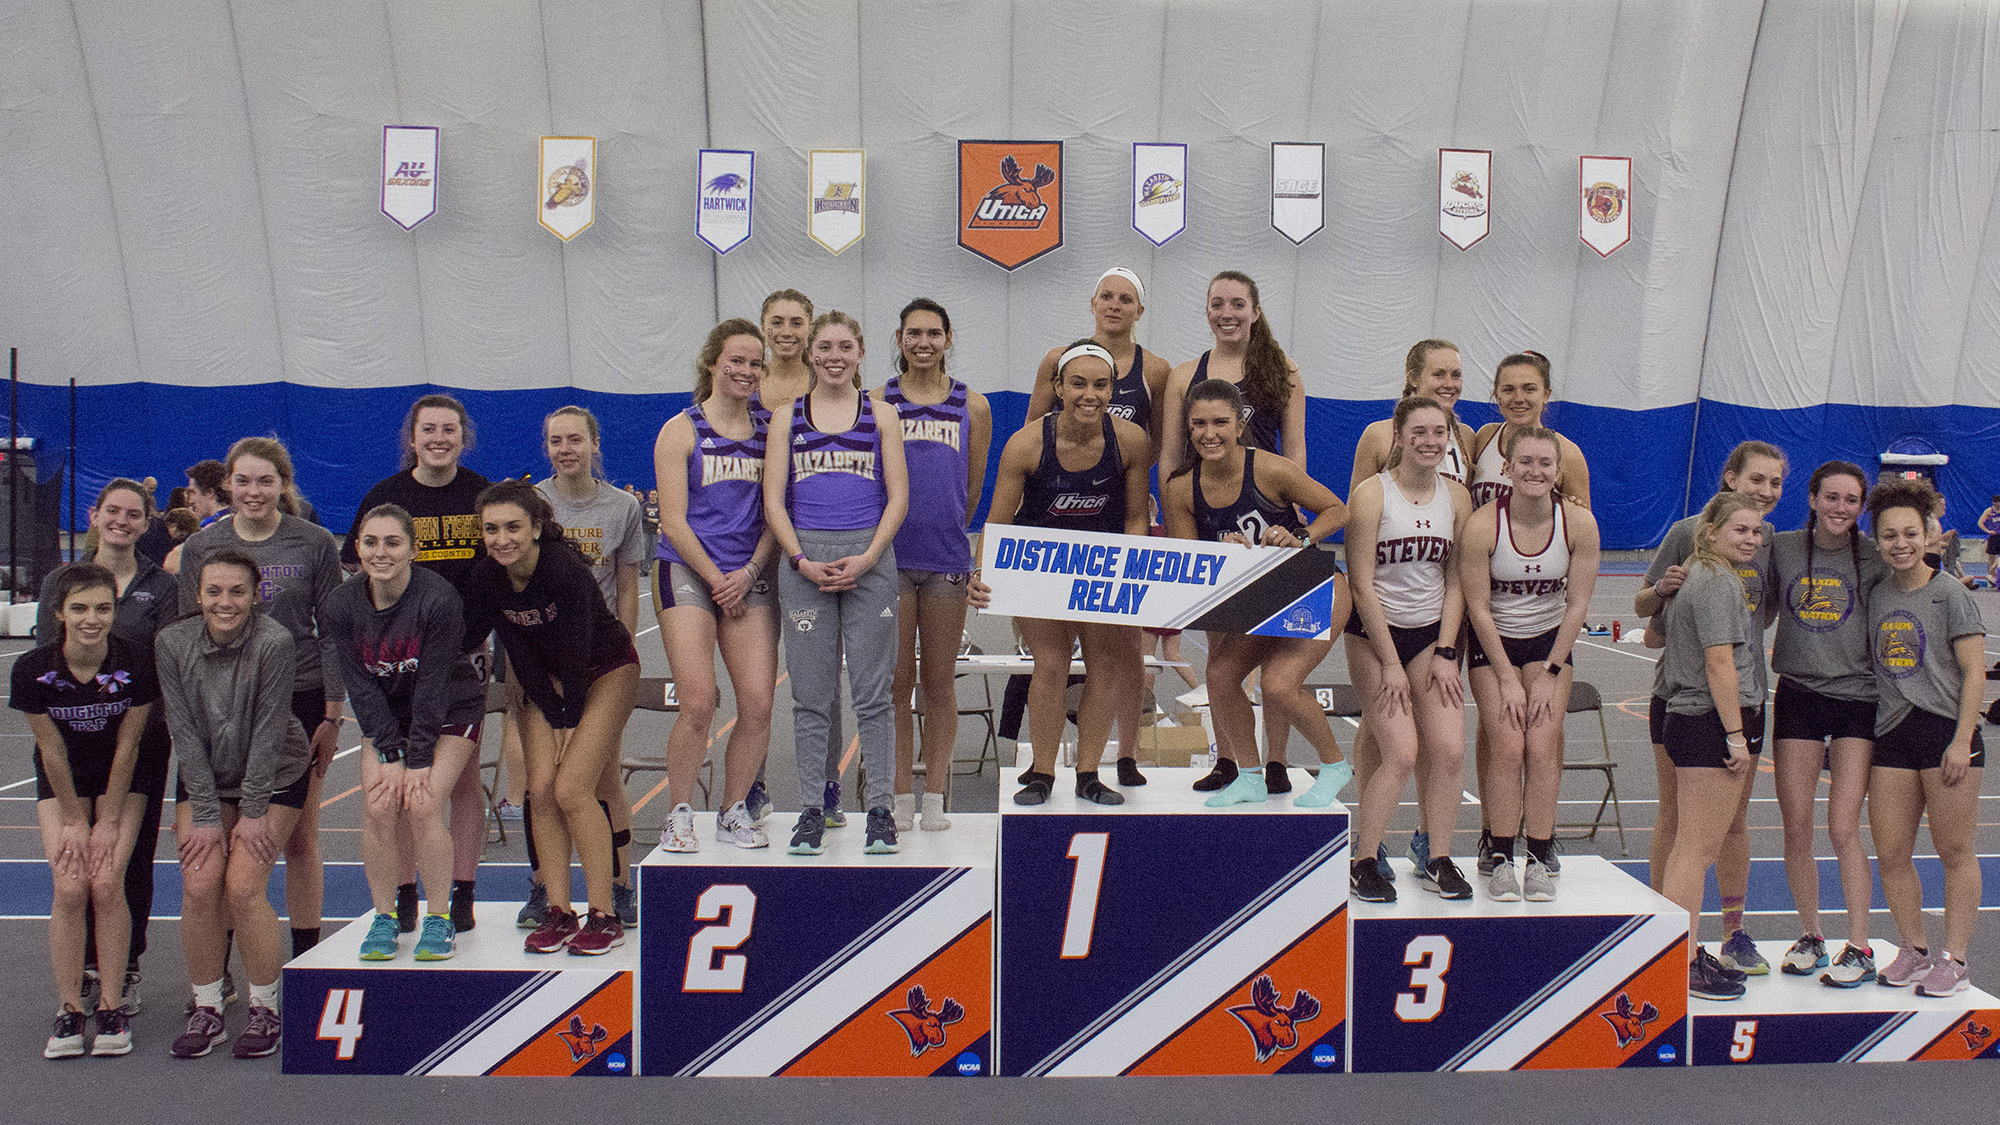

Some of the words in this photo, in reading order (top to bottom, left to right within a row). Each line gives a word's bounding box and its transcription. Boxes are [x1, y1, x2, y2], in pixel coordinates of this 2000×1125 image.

[394, 161, 430, 178] AU
[1276, 179, 1318, 192] SAGE
[703, 196, 747, 211] HARTWICK
[977, 199, 1047, 220] UTICA
[793, 450, 876, 484] NAZARETH
[1447, 448, 1460, 474] 1
[1054, 496, 1107, 510] UTICA
[1242, 516, 1263, 545] 2
[431, 550, 473, 558] COUNTRY
[994, 537, 1122, 579] DISTANCE
[1122, 548, 1228, 586] MEDLEY
[1067, 578, 1150, 615] RELAY
[1318, 689, 1331, 709] 3
[69, 717, 108, 732] T&F
[1060, 832, 1110, 959] 1
[682, 884, 757, 993] 2
[1394, 934, 1454, 1022] 3
[315, 988, 365, 1060] 4
[1729, 1020, 1758, 1062] 5
[958, 1063, 980, 1071] NCAA
[1314, 1055, 1335, 1063] NCAA
